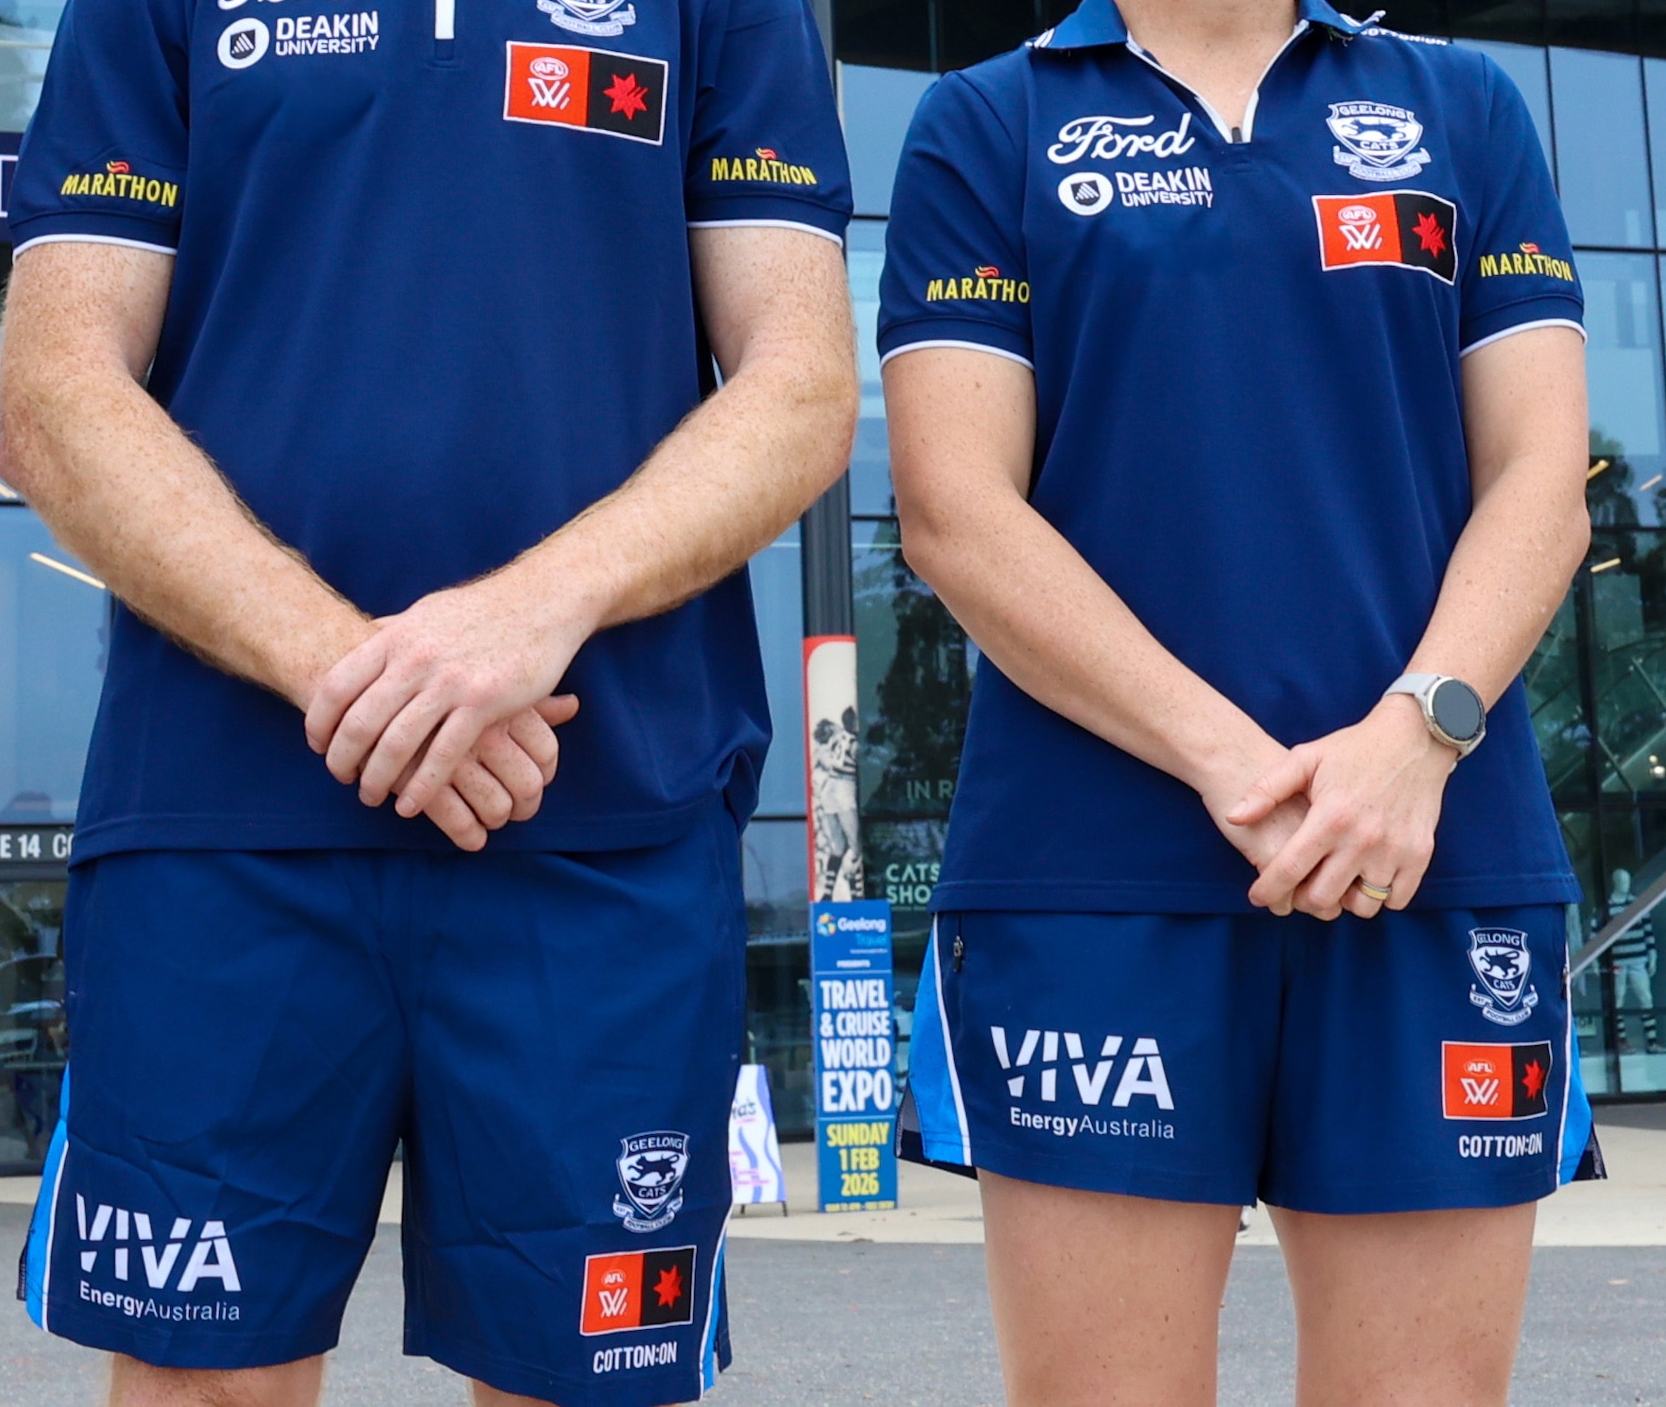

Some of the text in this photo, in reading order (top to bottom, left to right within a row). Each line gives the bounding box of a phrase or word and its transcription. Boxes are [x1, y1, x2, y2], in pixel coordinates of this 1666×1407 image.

[276, 11, 378, 40] DEAKIN
[276, 35, 379, 56] UNIVERSITY
[535, 62, 564, 76] AFL
[1339, 105, 1406, 119] GEELONG
[1047, 112, 1195, 164] Ford
[1360, 140, 1399, 150] CATS
[712, 157, 817, 184] MARATHON
[1115, 167, 1212, 192] DEAKIN
[61, 173, 178, 207] MARATHON
[1121, 191, 1213, 208] UNIVERSITY
[1344, 210, 1372, 220] AFL
[1480, 251, 1573, 282] MARATHON
[907, 780, 931, 799] IN
[18, 834, 41, 858] 14
[886, 863, 941, 883] CATS
[837, 917, 886, 933] Geelong
[820, 980, 888, 1009] TRAVEL
[1493, 979, 1516, 991] CATS
[820, 1011, 891, 1037] & CRUISE
[821, 1038, 891, 1069] WORLD
[990, 1026, 1174, 1110] VIVA
[1467, 1063, 1492, 1073] AFL
[823, 1069, 892, 1112] EXPO
[827, 1122, 890, 1147] SUNDAY
[1010, 1107, 1175, 1139] EnergyAustralia
[629, 1136, 682, 1152] GEELONG
[1459, 1132, 1542, 1157] COTTON:ON
[839, 1148, 880, 1171] 1 FEB
[638, 1185, 667, 1198] CATS
[841, 1173, 879, 1196] 2026
[76, 1192, 242, 1292] VIVA
[604, 1273, 623, 1284] AFL
[80, 1281, 241, 1322] EnergyAustralia
[593, 1342, 677, 1373] COTTON:ON
